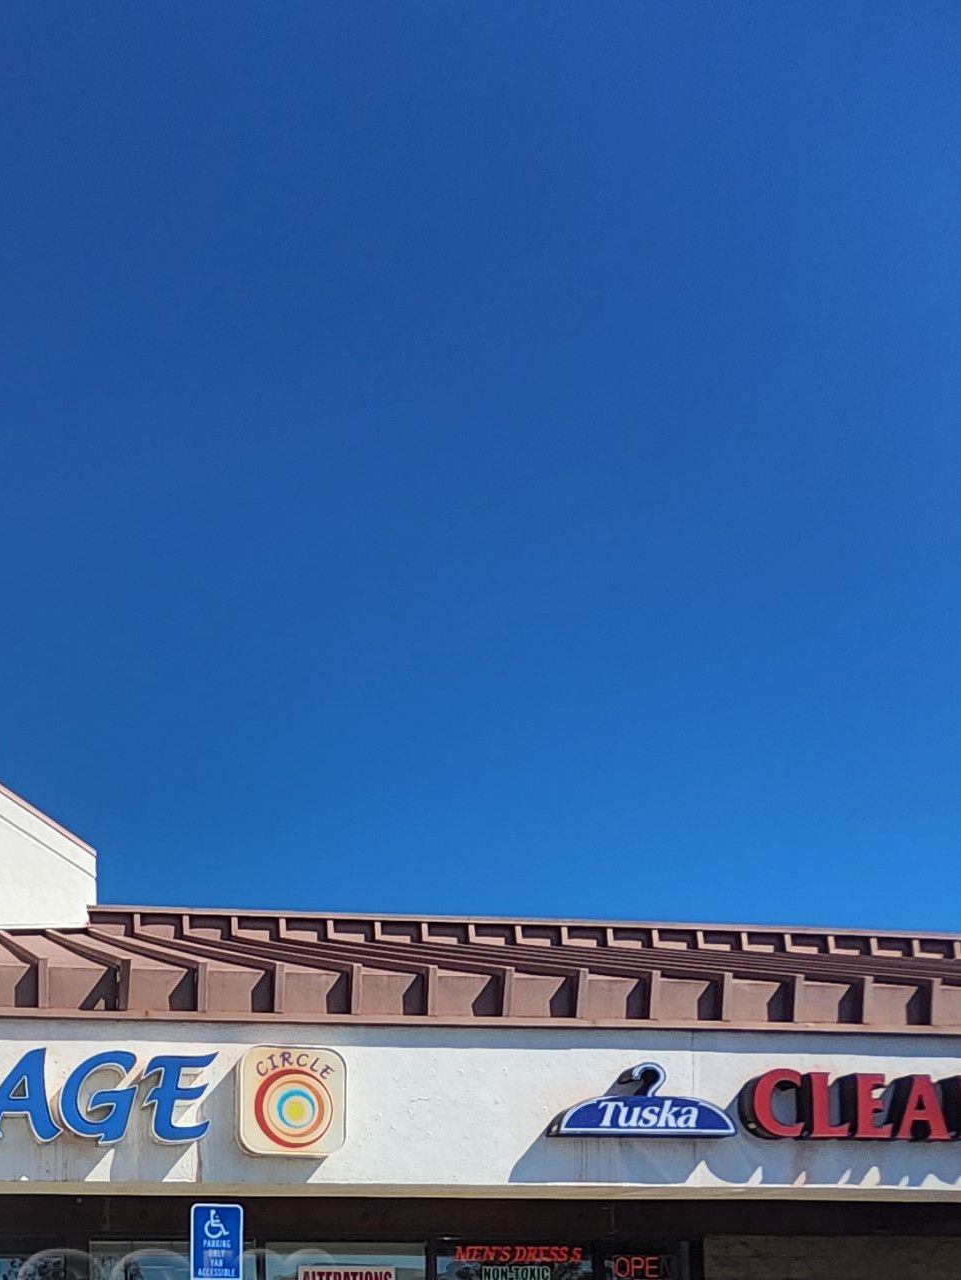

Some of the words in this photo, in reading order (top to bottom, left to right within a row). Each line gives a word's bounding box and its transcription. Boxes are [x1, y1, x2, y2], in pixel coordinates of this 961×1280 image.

[255, 1051, 336, 1080] CIRCLE
[752, 1067, 961, 1141] CLEA
[598, 1099, 700, 1128] Tuska
[203, 1239, 231, 1248] PARKING
[208, 1249, 226, 1257] ONLY
[454, 1245, 511, 1263] MEN'S
[197, 1268, 236, 1277] ACCESSIBLE
